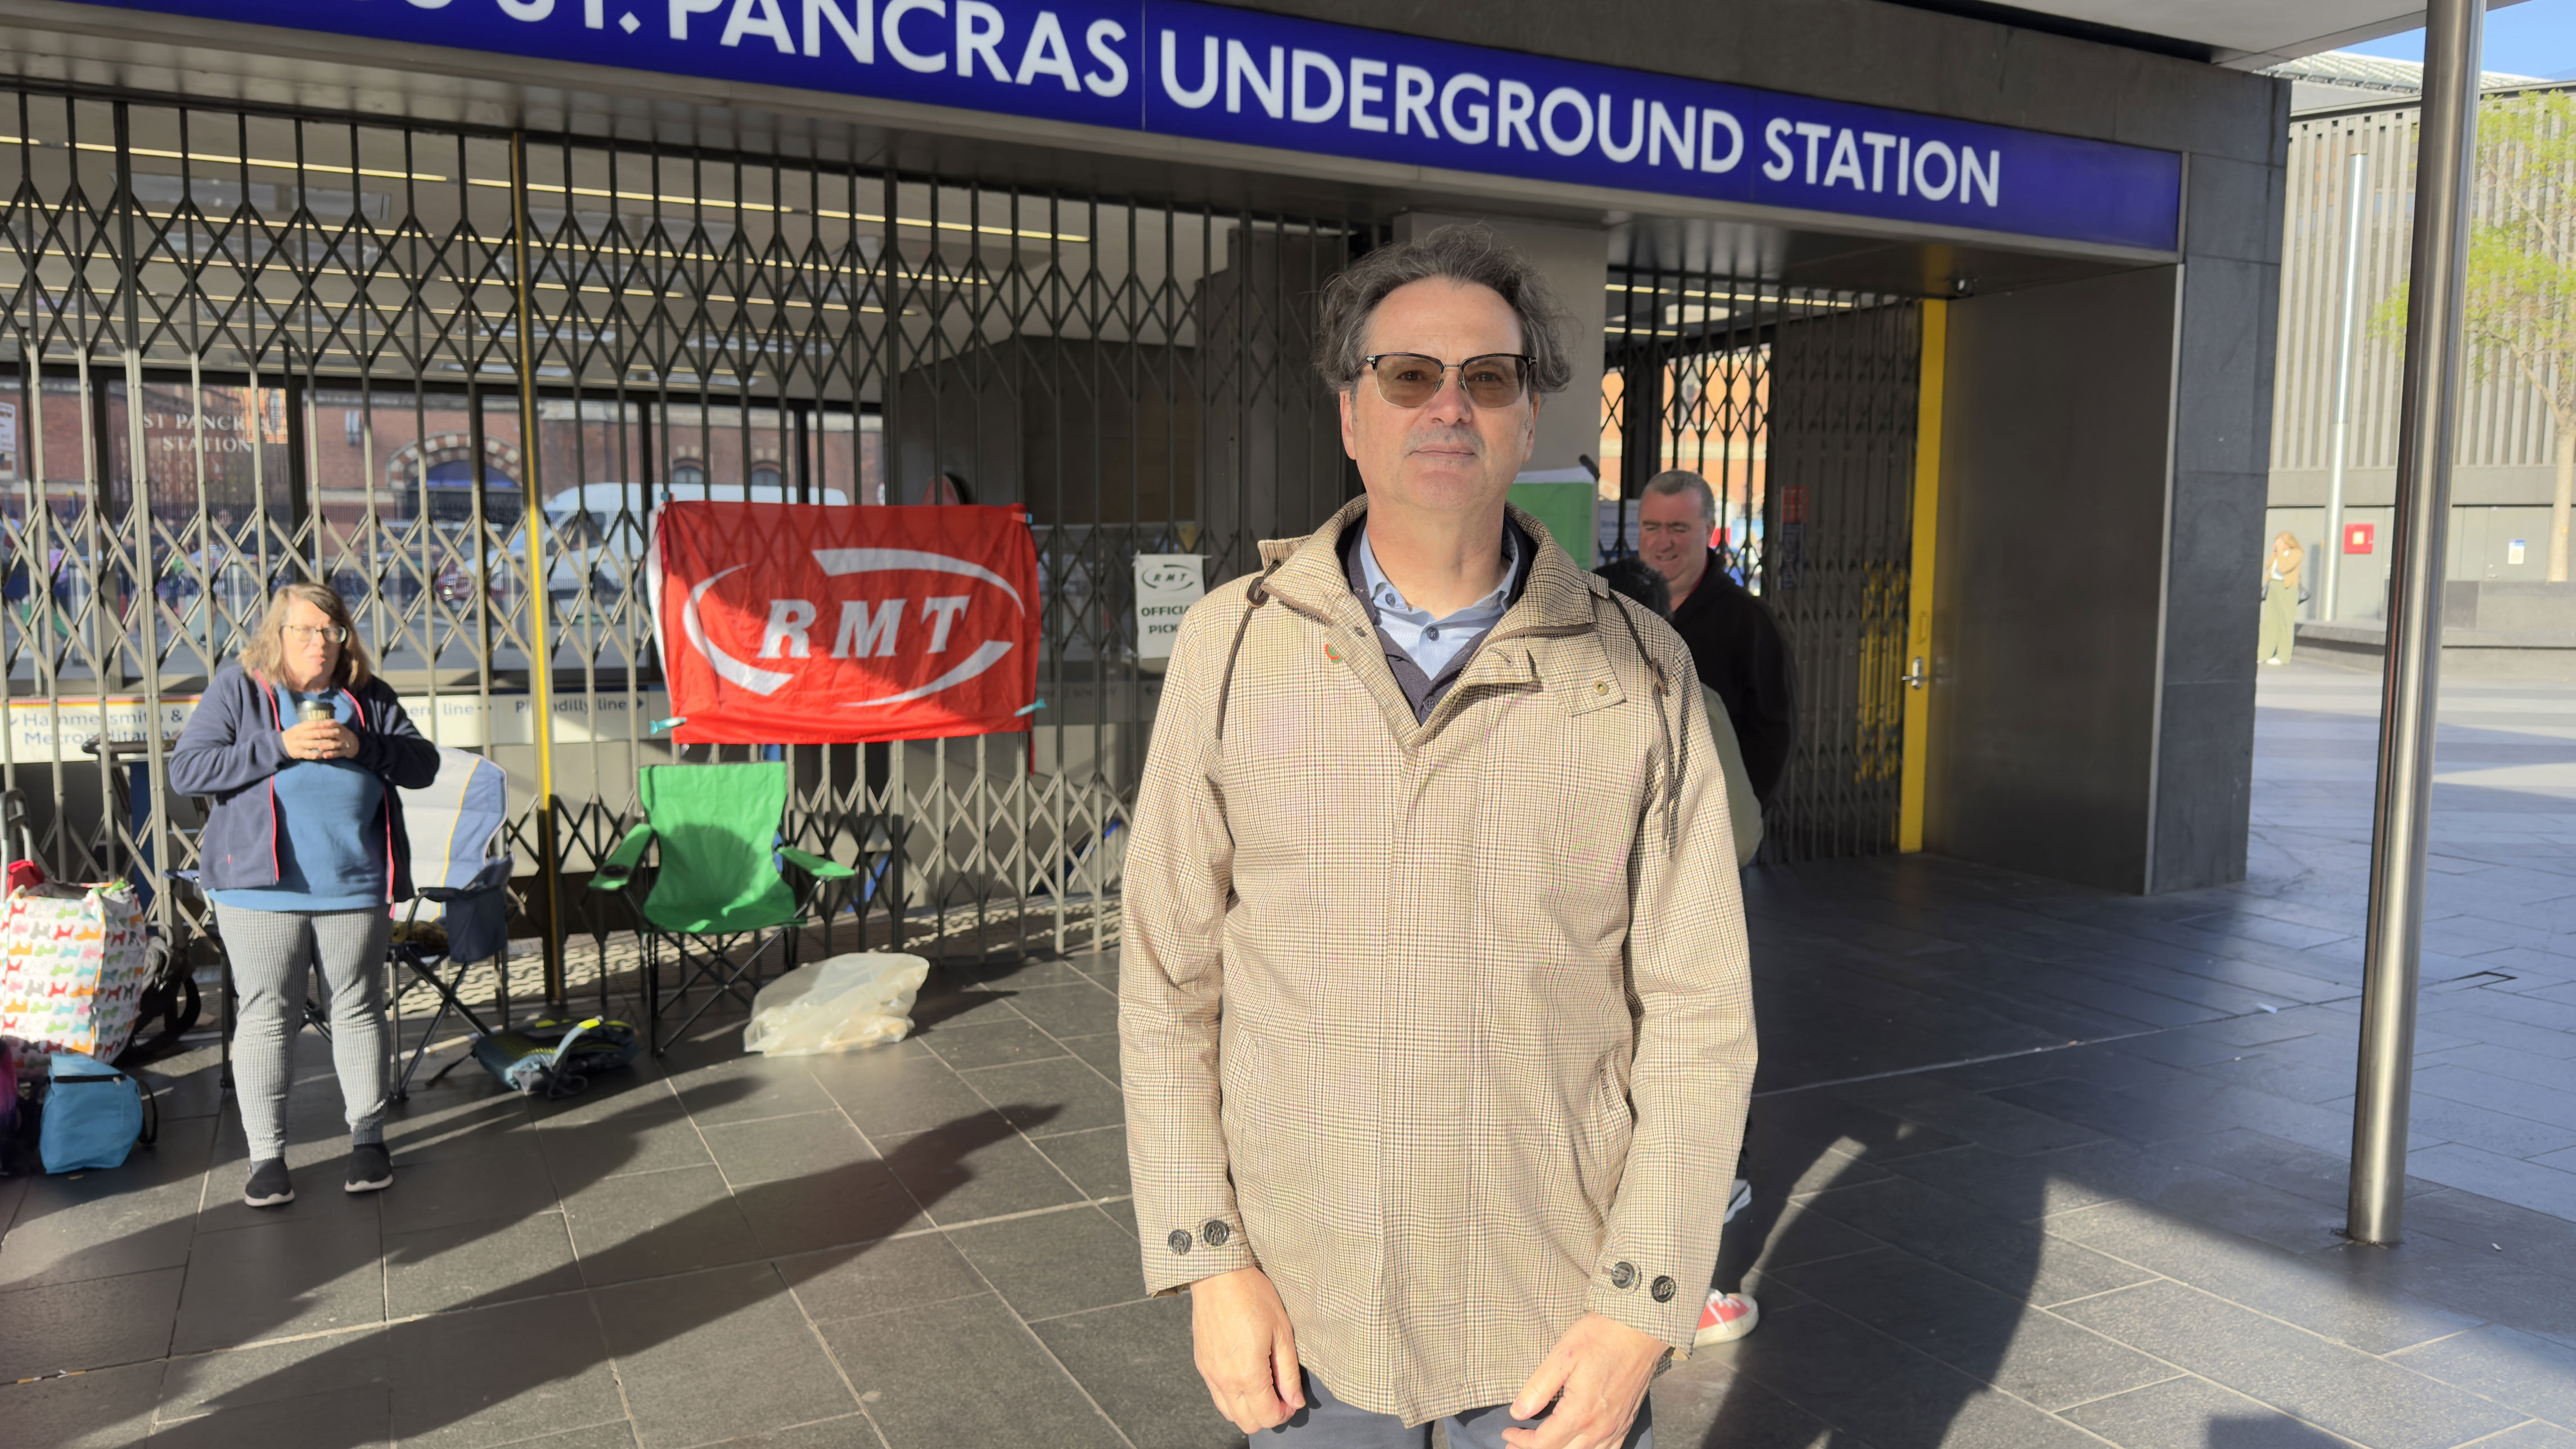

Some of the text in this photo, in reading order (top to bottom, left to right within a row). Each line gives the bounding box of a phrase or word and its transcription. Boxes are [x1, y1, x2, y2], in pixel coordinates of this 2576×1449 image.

[1161, 30, 1743, 173] UNDERGROUND
[1763, 119, 1999, 206] STATION
[143, 413, 271, 432] ST PANCRS
[163, 435, 253, 453] STATION
[1154, 573, 1187, 582] RMT
[756, 594, 971, 659] RMT
[1149, 624, 1178, 634] PICK
[443, 703, 474, 716] line
[598, 698, 627, 711] line
[171, 709, 182, 723] &
